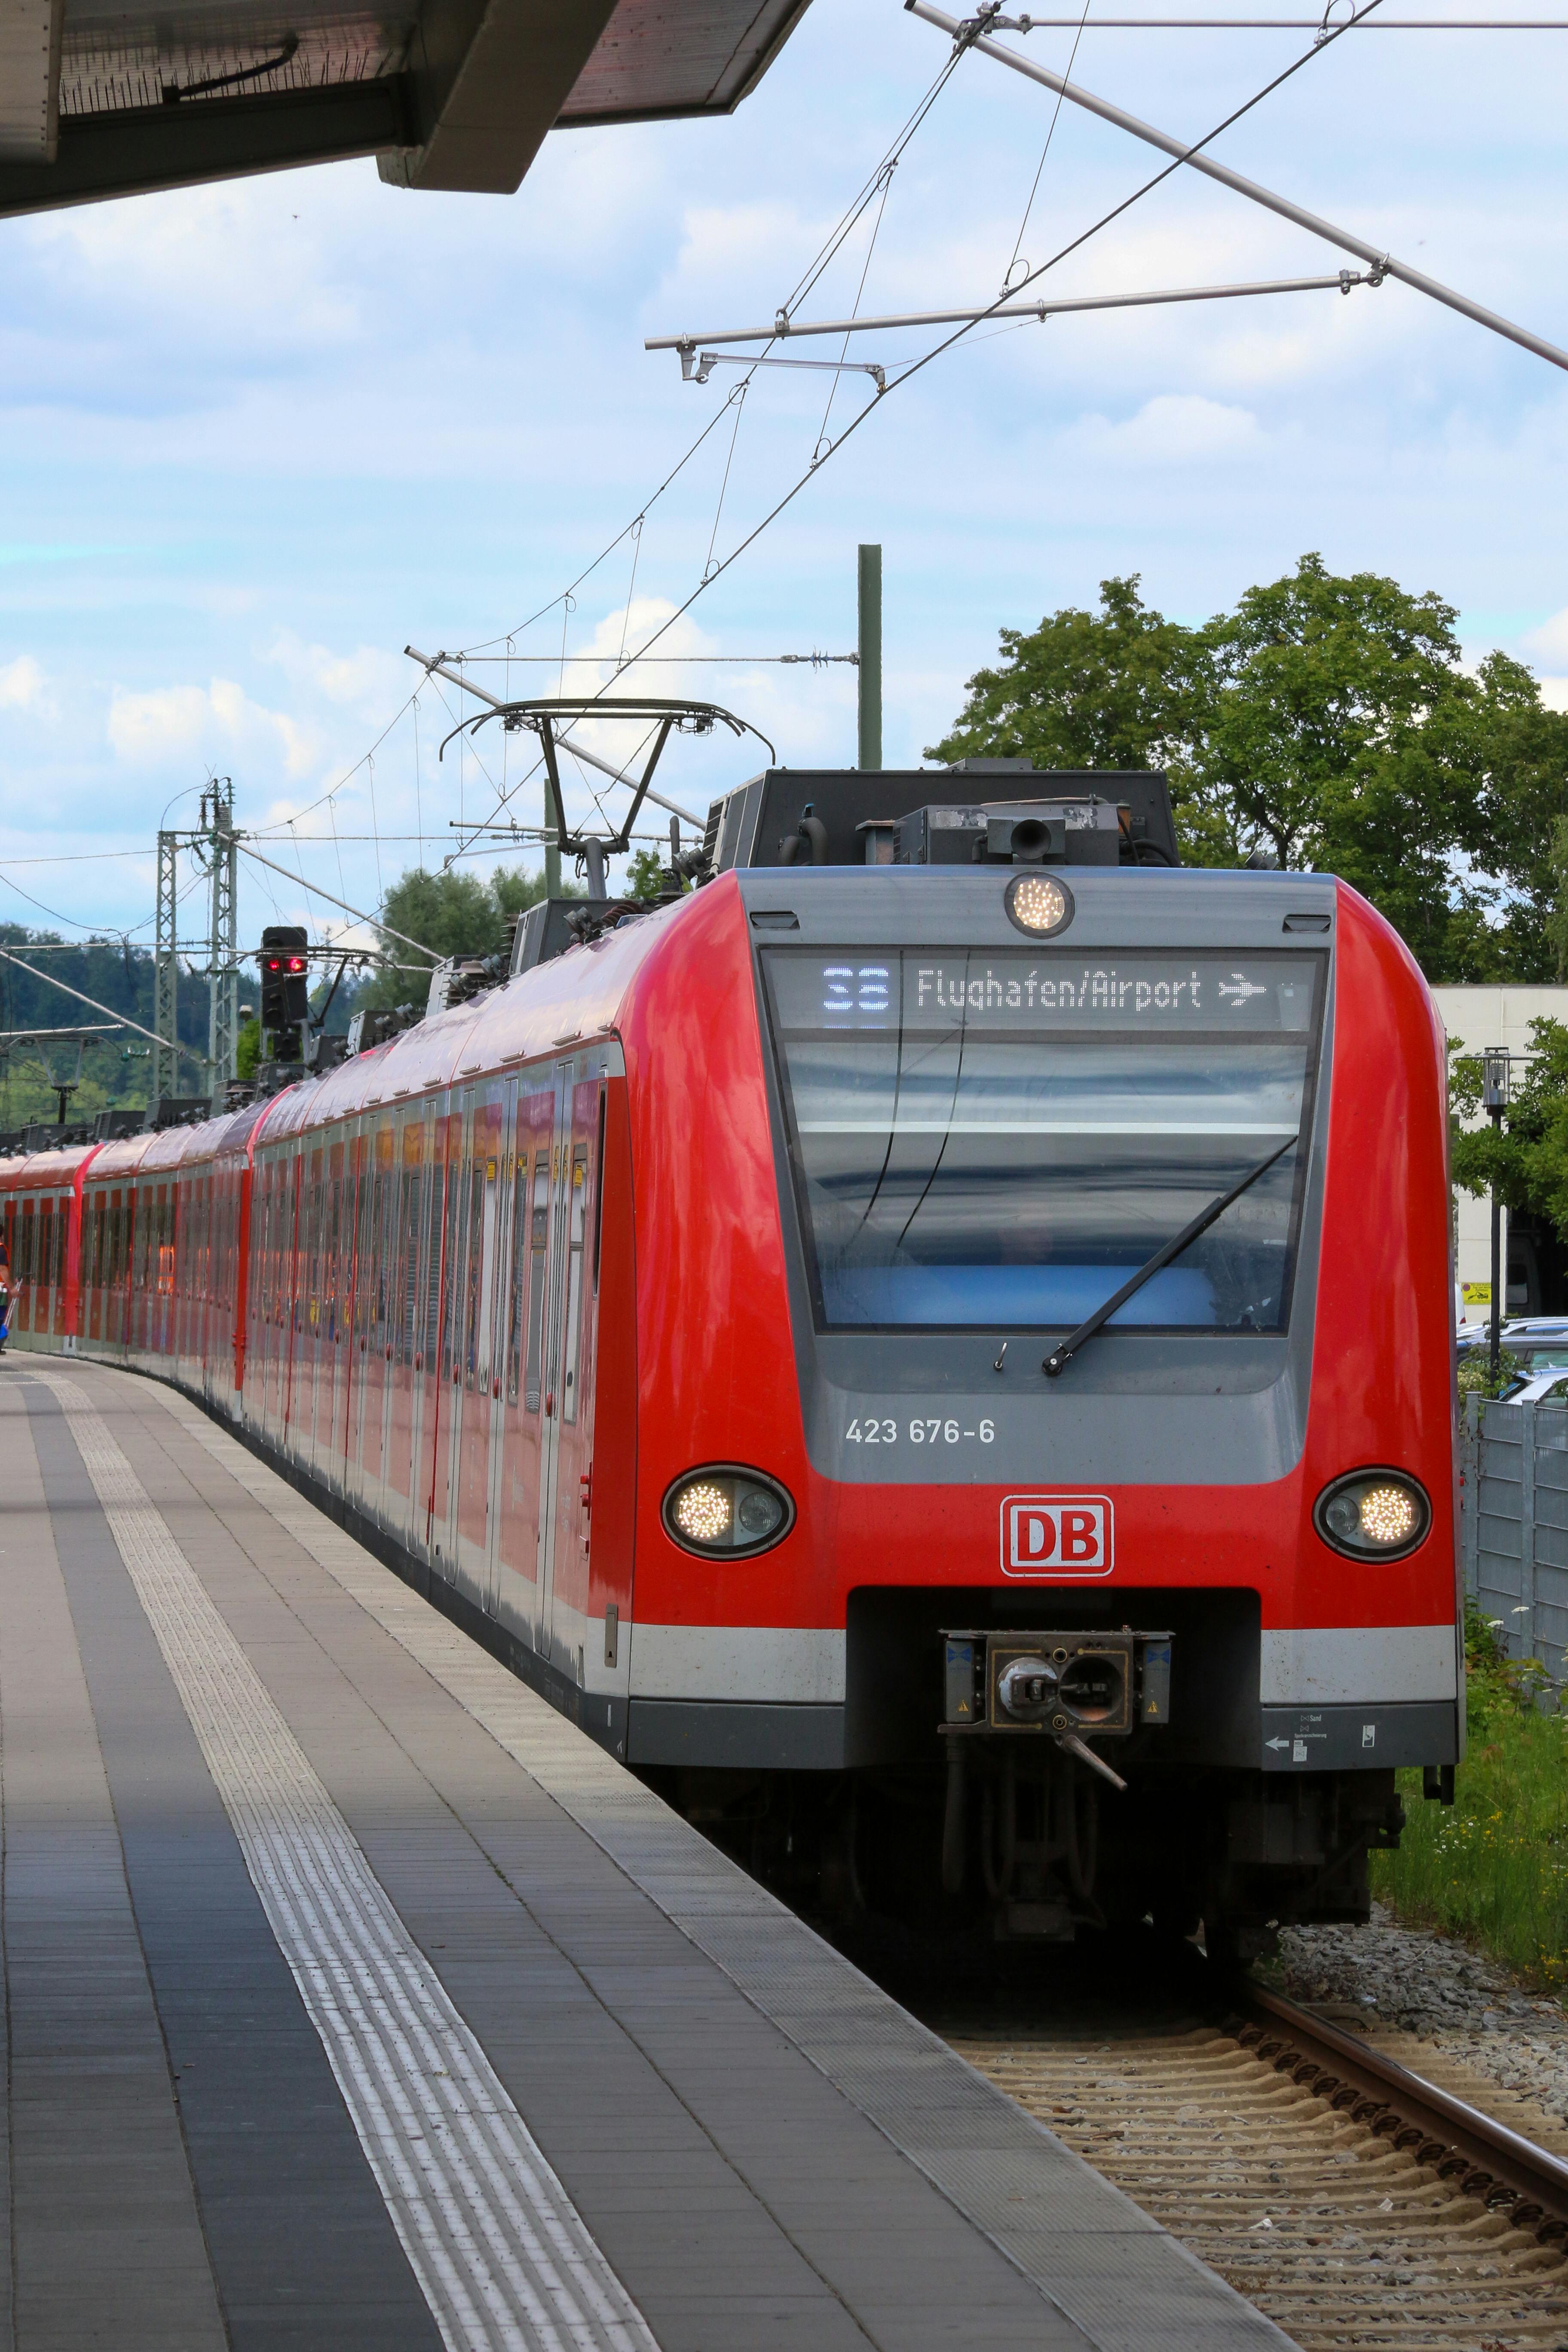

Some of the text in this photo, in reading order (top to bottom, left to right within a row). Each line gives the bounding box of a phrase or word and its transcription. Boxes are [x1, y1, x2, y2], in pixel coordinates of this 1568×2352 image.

[919, 970, 1201, 1011] Flughafen/Airport
[845, 1419, 995, 1443] 423 676-6
[1017, 1510, 1099, 1562] DB
